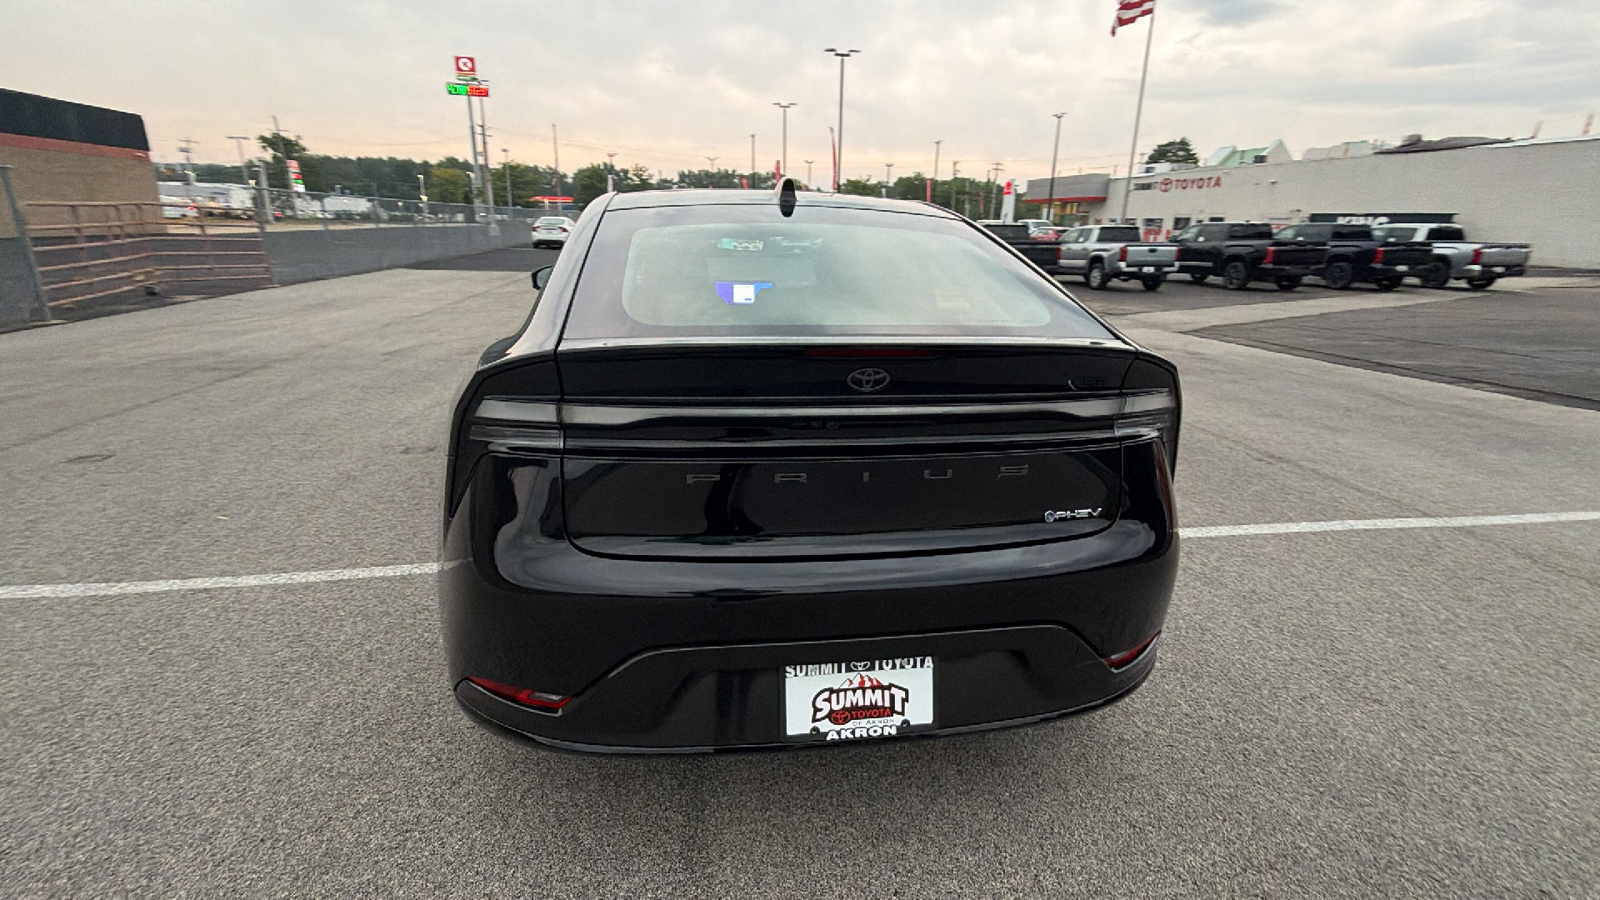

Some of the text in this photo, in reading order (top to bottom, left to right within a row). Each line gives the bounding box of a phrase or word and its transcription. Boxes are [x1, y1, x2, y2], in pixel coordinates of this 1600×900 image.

[1174, 176, 1222, 190] TOYOTA
[686, 463, 1029, 484] PRIUS
[1053, 507, 1103, 520] PHEV
[785, 656, 934, 678] SUMMIT TOYOTA
[813, 684, 908, 721] SUMMIT
[851, 708, 892, 719] TOYOTA
[826, 725, 898, 741] AKRON
